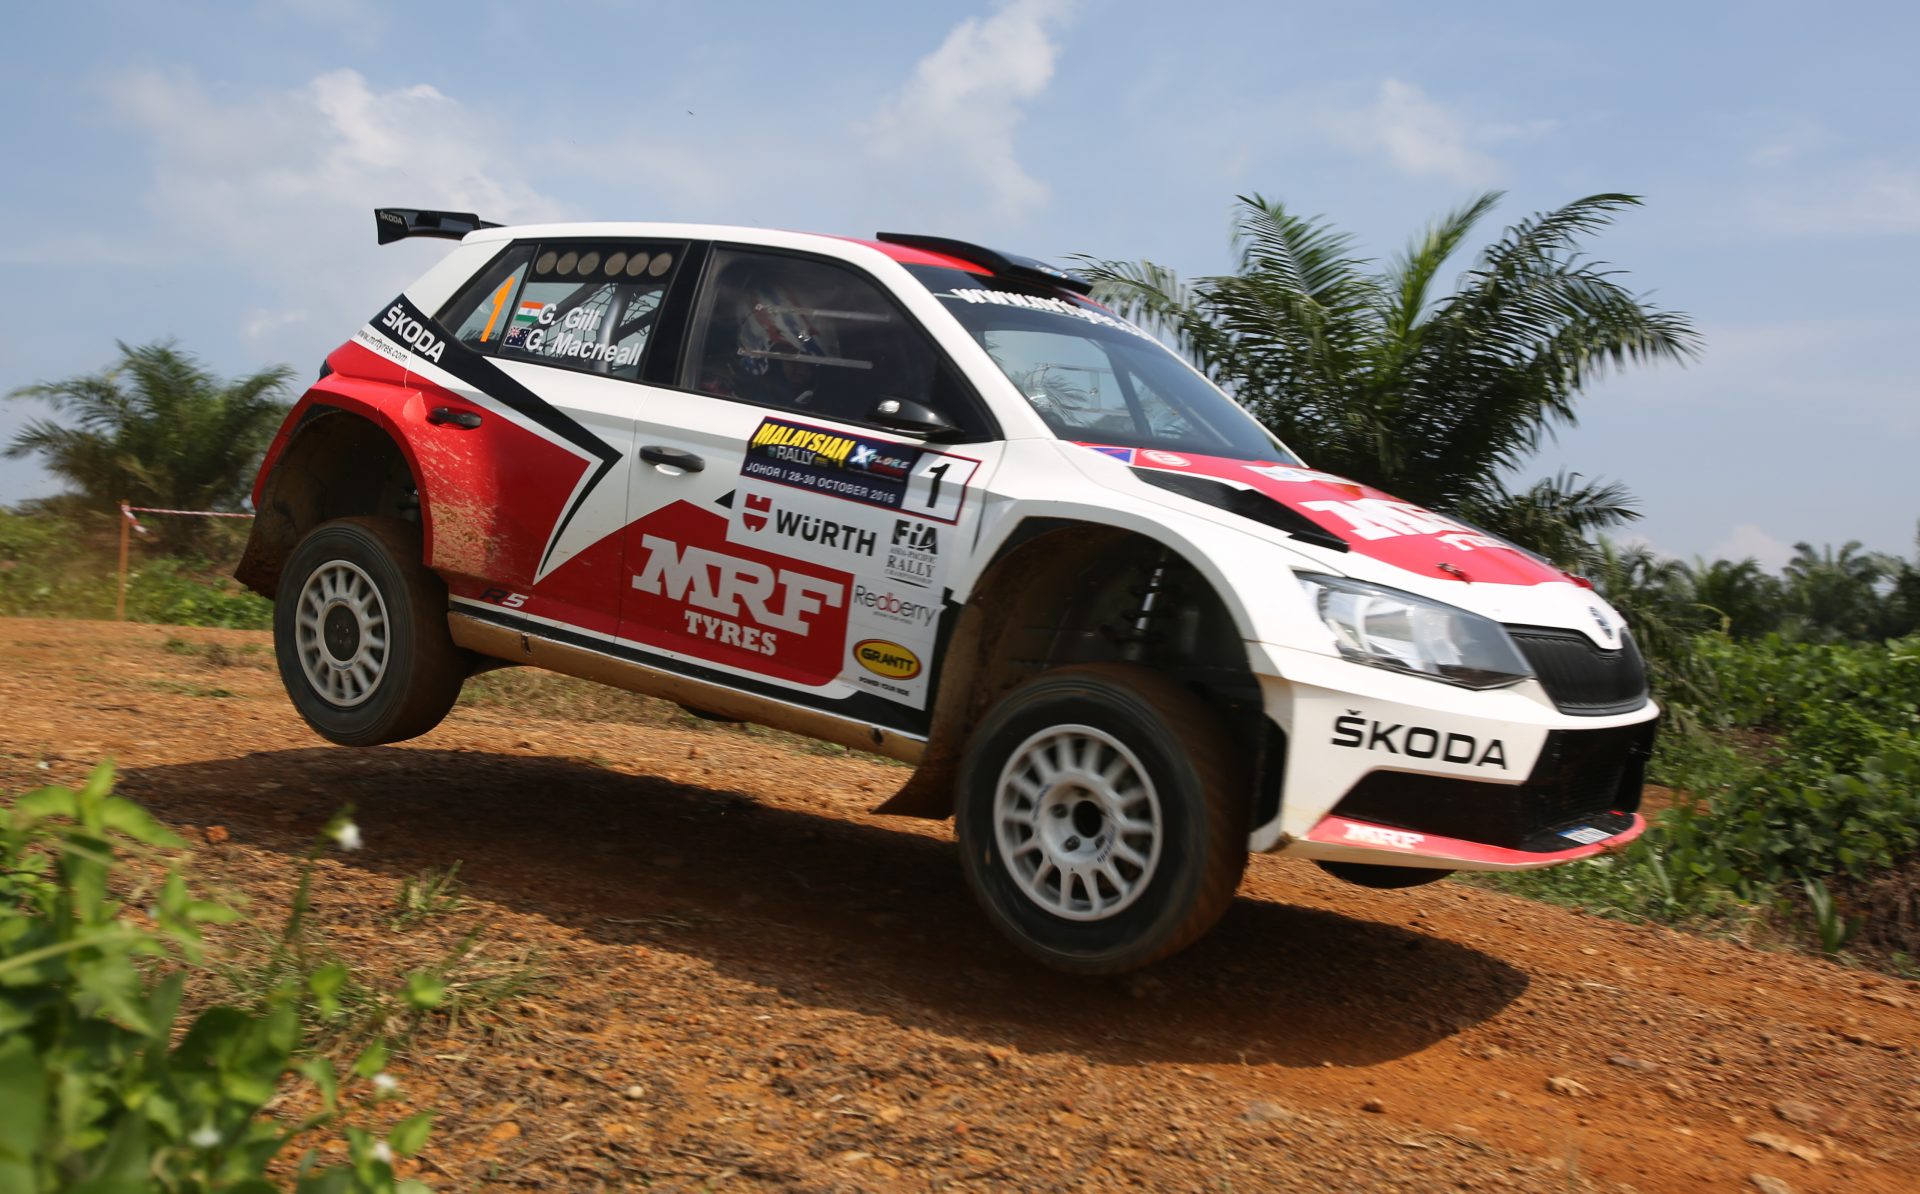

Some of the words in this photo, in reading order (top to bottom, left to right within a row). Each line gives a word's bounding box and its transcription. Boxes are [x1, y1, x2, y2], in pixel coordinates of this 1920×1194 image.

[480, 276, 515, 342] 1
[538, 303, 557, 326] G.
[565, 306, 600, 332] Gill
[382, 303, 446, 363] ŠKODA
[525, 328, 544, 351] G.
[549, 331, 645, 367] Macneall
[752, 422, 857, 463] MALAYSIAN
[776, 445, 816, 466] RALLY
[746, 462, 779, 478] JOHOR
[788, 471, 815, 486] 28-30
[817, 477, 869, 498] OCTOBER
[870, 489, 896, 504] 2016
[925, 463, 952, 509] 1
[632, 533, 844, 637] MRF
[885, 554, 937, 578] RALLY
[853, 584, 937, 627] Redberry
[684, 609, 777, 656] TYRES
[861, 647, 915, 672] GRANTT
[1332, 709, 1509, 770] ŠKODA
[1343, 823, 1425, 850] MRF
